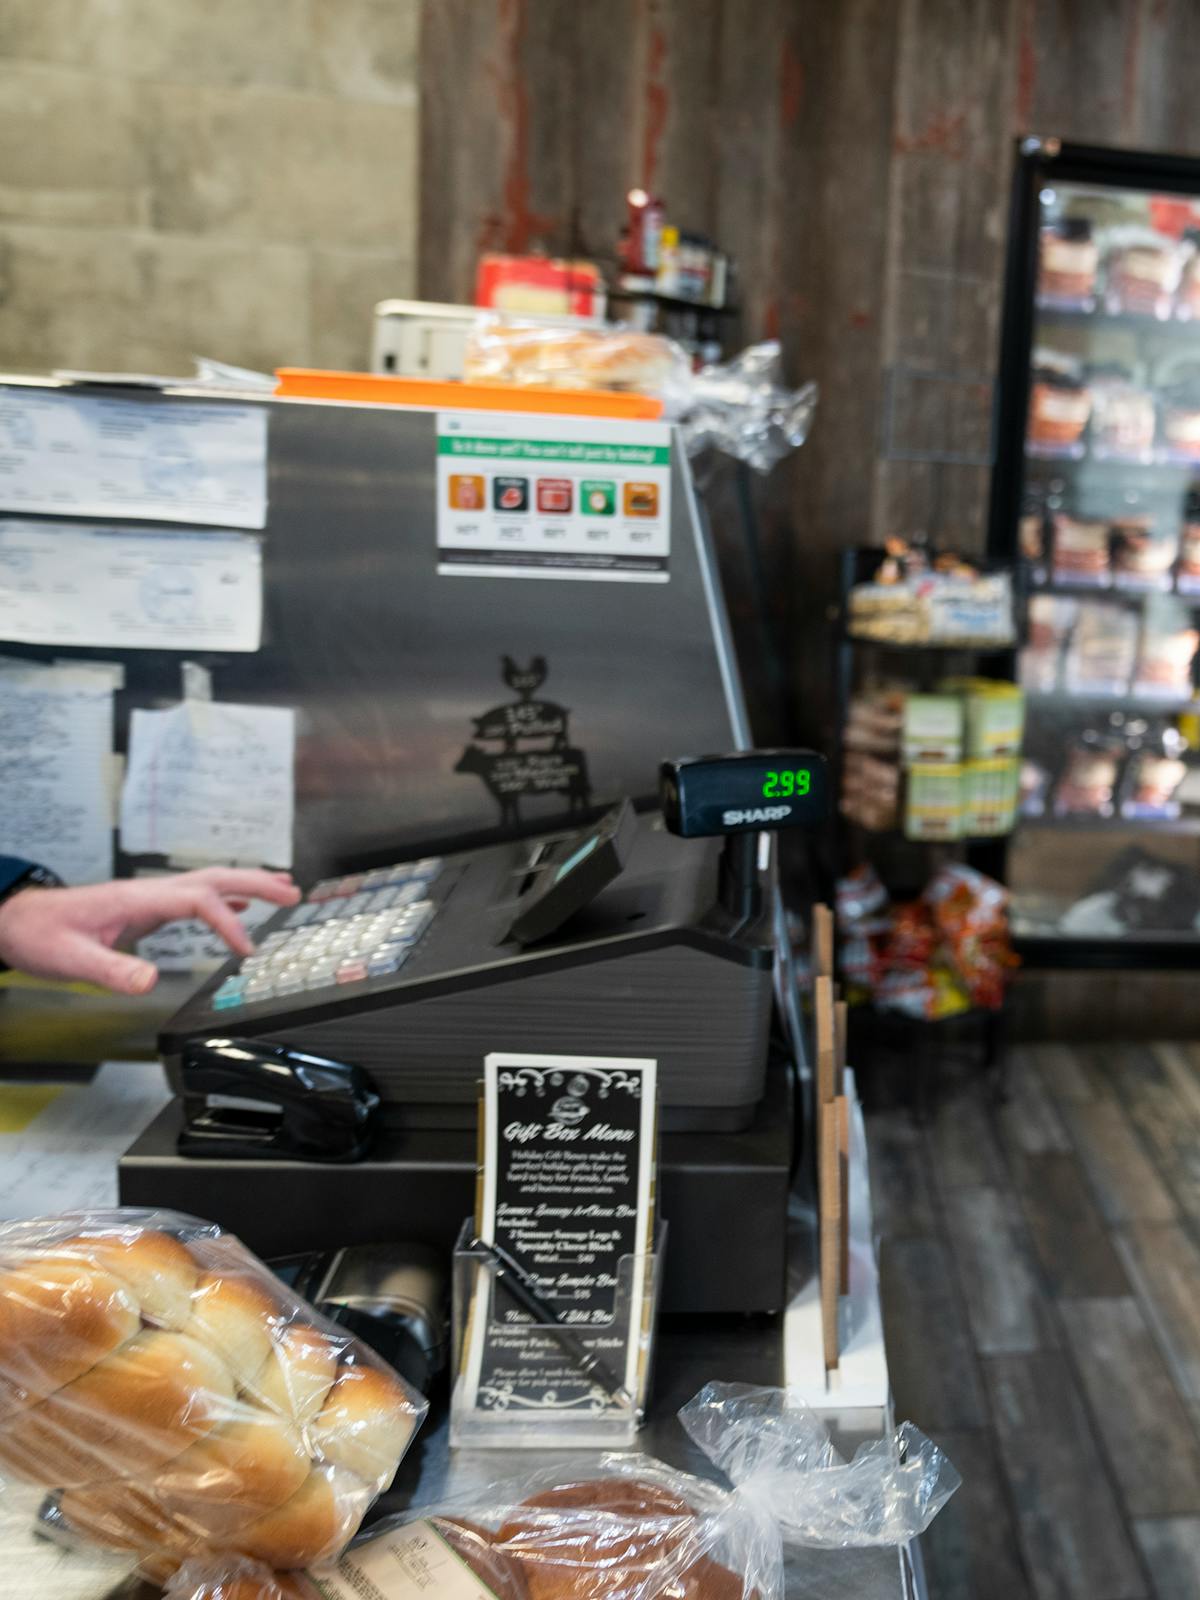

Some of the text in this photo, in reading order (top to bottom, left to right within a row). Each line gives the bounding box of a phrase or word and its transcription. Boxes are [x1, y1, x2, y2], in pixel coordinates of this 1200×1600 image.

[762, 769, 811, 798] 2.99
[722, 805, 792, 826] SHARP
[503, 1121, 636, 1144] Gift Box Menu
